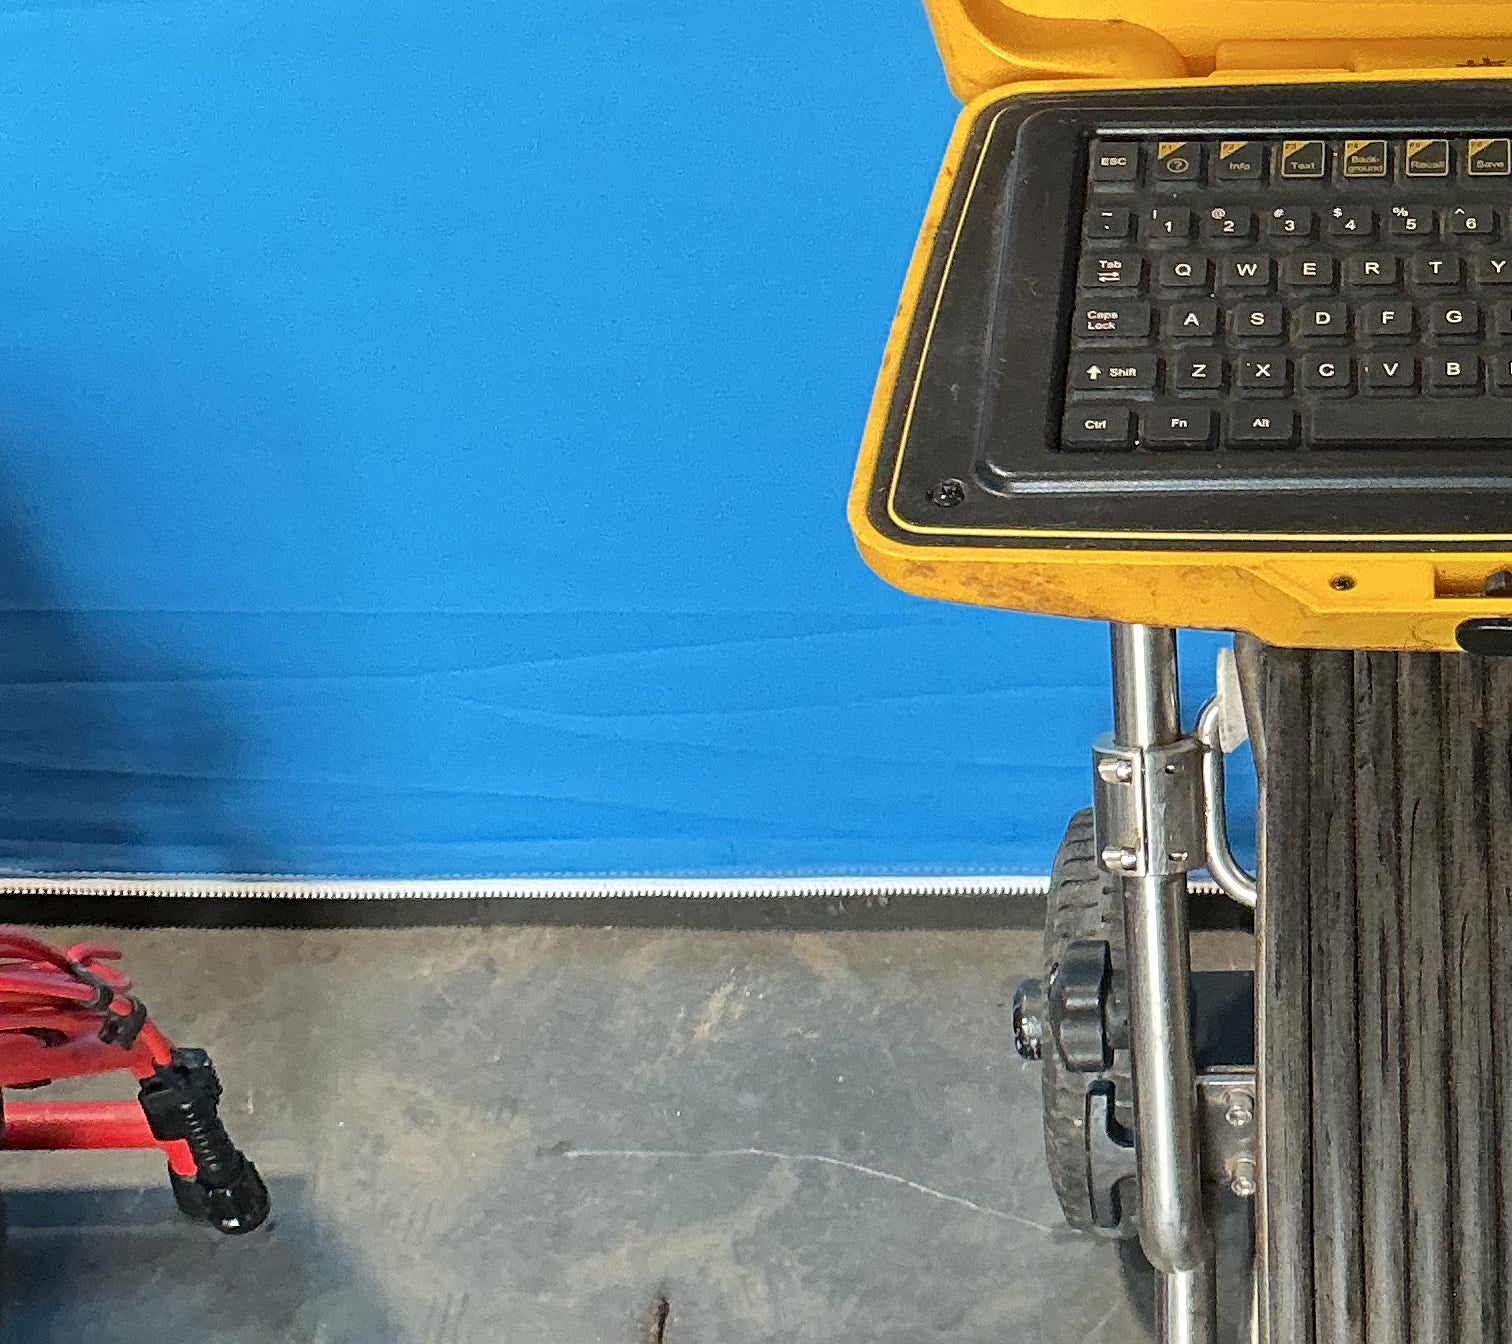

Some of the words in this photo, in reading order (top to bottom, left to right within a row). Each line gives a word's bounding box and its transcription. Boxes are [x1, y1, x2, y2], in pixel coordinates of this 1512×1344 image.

[1100, 157, 1127, 166] ESC
[1229, 161, 1251, 171] Info
[1290, 161, 1316, 170] Text
[1410, 160, 1445, 169] Recall
[1476, 159, 1505, 169] Save
[1211, 207, 1226, 220] @
[1273, 208, 1285, 218] #
[1332, 207, 1343, 219] $
[1392, 206, 1409, 217] %
[1164, 221, 1172, 233] 1
[1223, 220, 1235, 233] 2
[1284, 219, 1295, 232] 3
[1344, 219, 1357, 231] 4
[1405, 218, 1417, 230] 5
[1465, 217, 1477, 230] 6
[1098, 259, 1122, 269] Tab
[1174, 263, 1192, 277] Q
[1236, 263, 1258, 277] W
[1303, 262, 1317, 276] E
[1365, 261, 1380, 275] R
[1428, 261, 1443, 274] T
[1490, 260, 1507, 274] Y
[1087, 310, 1119, 321] Caps
[1183, 312, 1200, 327] A
[1250, 312, 1265, 326] S
[1315, 311, 1331, 325] D
[1382, 310, 1395, 325] F
[1445, 310, 1463, 323] G
[1087, 321, 1116, 330] Lock
[1109, 367, 1137, 378] Shift
[1191, 363, 1207, 378] Z
[1255, 363, 1271, 377] X
[1318, 363, 1335, 377] C
[1382, 362, 1399, 377] V
[1446, 362, 1461, 376] B
[1084, 419, 1107, 430] Ctrl
[1171, 418, 1188, 428] Fn
[1252, 418, 1271, 428] Alt
